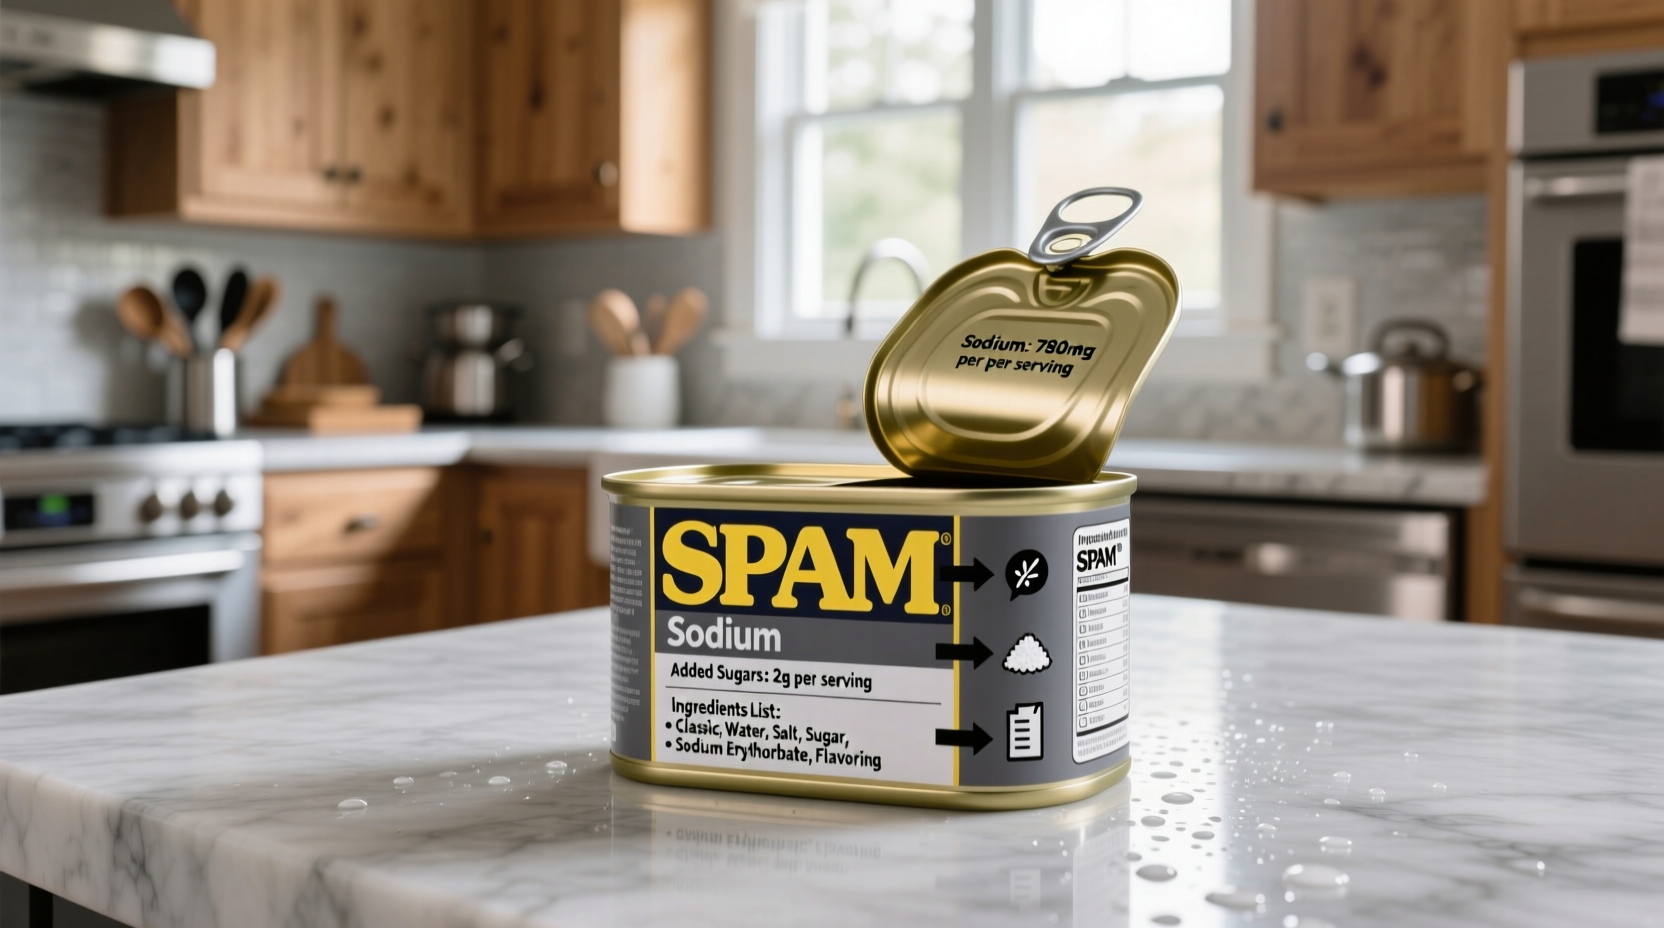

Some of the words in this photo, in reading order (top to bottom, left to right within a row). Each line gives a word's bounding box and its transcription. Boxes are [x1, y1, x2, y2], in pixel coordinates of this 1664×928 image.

[960, 334, 1033, 353] Sodium:
[955, 355, 985, 369] per
[984, 357, 1012, 372] per
[1013, 359, 1074, 378] serving
[1076, 544, 1117, 573] SPAM
[667, 615, 782, 652] Sodium
[670, 662, 714, 679] Added
[717, 664, 769, 686] Sugars:
[773, 668, 790, 689] 2g
[794, 673, 817, 689] per
[820, 672, 872, 693] serving
[672, 696, 748, 718] Ingredients
[750, 702, 781, 719] List:
[725, 721, 769, 741] Water,
[772, 724, 802, 745] Salt,
[805, 726, 849, 750] Sugar,
[675, 737, 723, 755] Sodium
[726, 741, 813, 767] Erythorbate,
[815, 747, 882, 772] Flavoring
